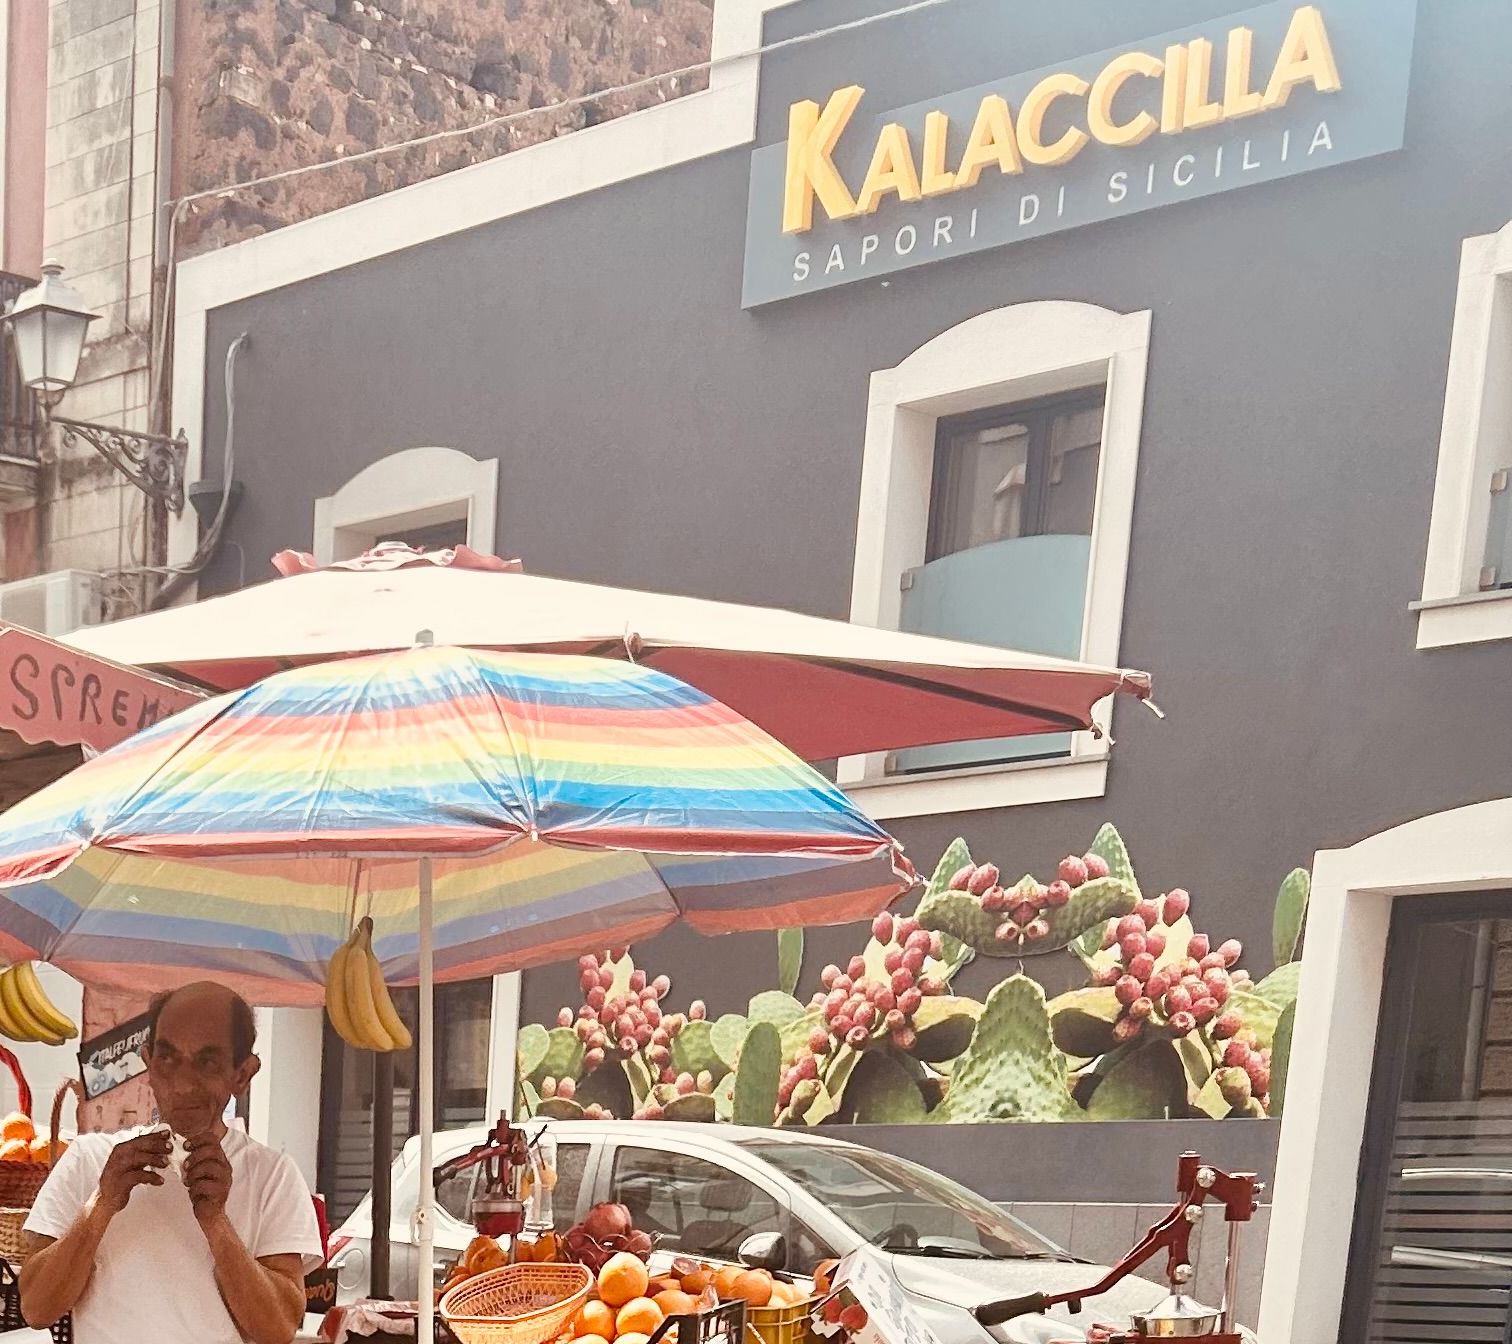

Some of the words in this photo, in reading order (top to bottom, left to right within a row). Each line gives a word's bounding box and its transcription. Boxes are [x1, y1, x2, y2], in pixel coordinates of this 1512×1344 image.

[782, 6, 1342, 233] KALACCILLA
[793, 209, 977, 281] SAPORI
[1019, 186, 1065, 225] DI
[1107, 121, 1333, 202] SICILIA
[10, 653, 175, 730] SPREM
